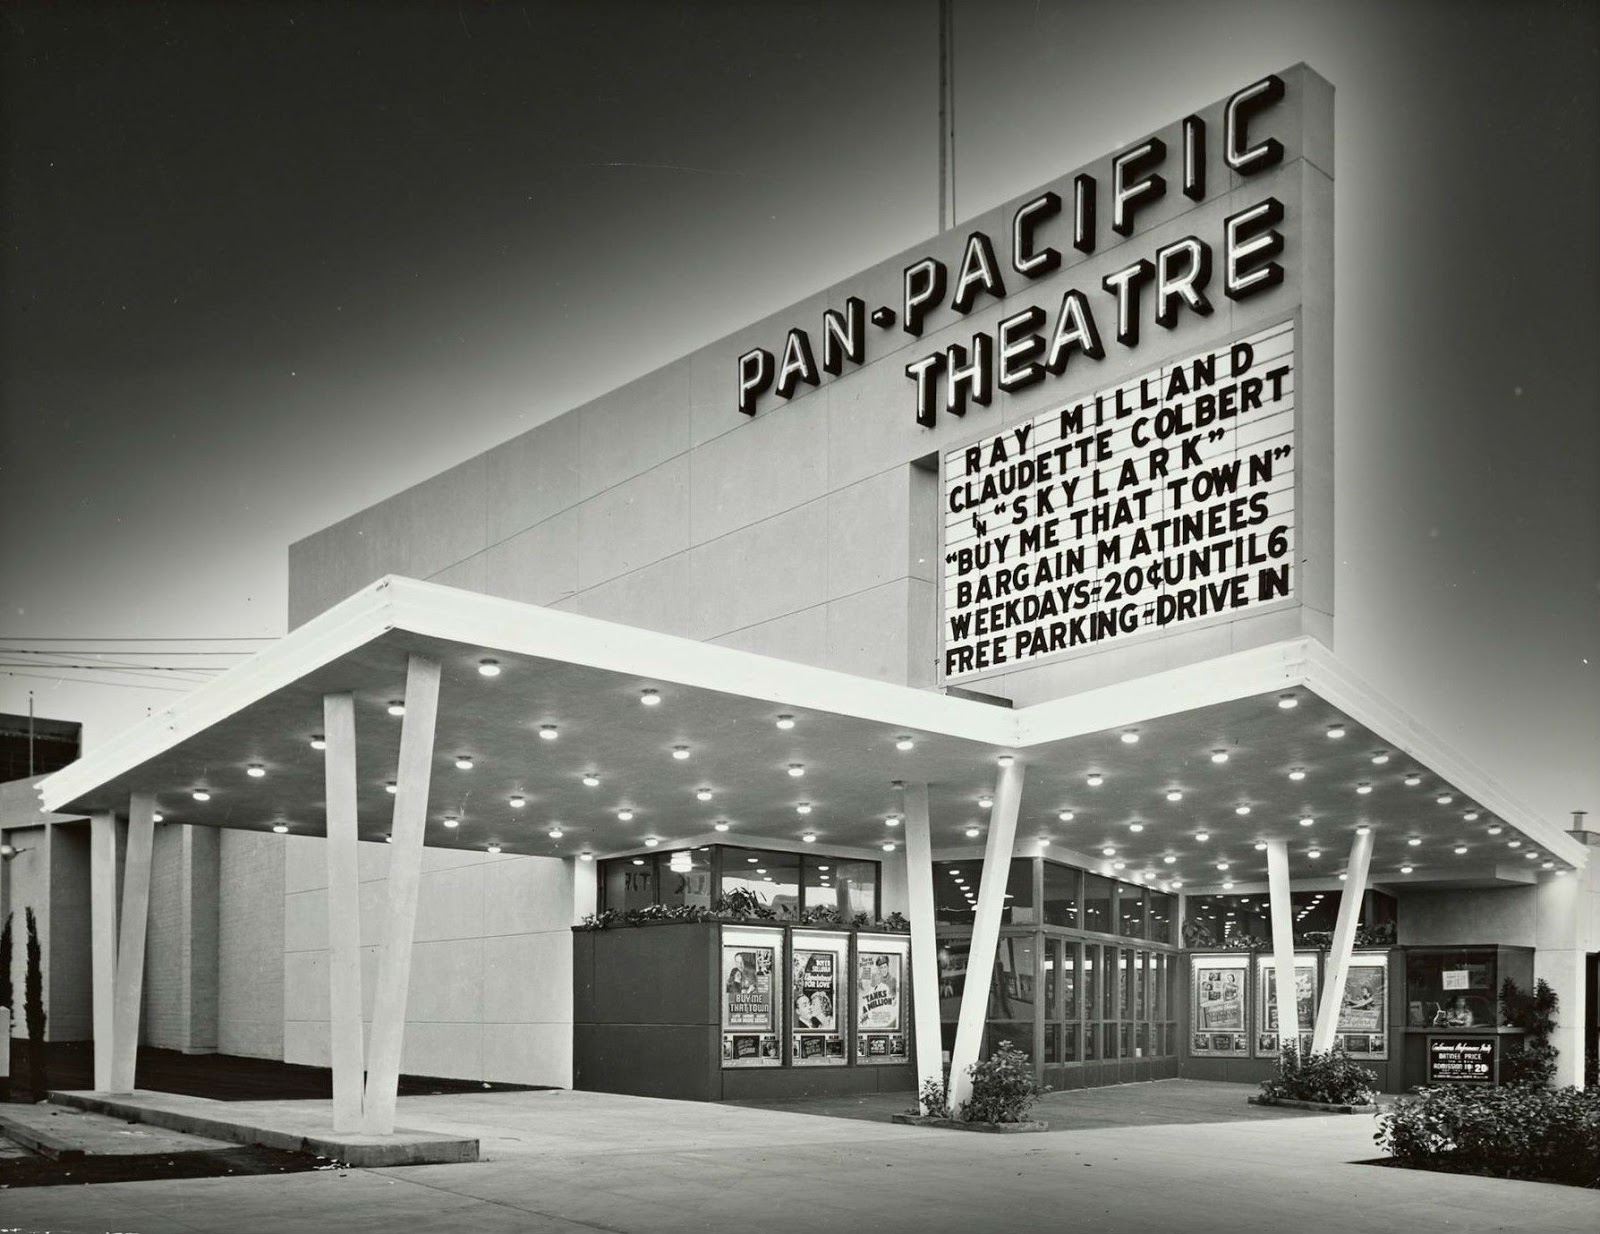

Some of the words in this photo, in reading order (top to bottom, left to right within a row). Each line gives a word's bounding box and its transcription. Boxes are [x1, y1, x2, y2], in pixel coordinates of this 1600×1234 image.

[905, 196, 1284, 428] THEATRE
[949, 429, 1113, 514] CLAUDETTE
[1131, 365, 1290, 448] COLBERT
[965, 424, 1032, 476] RAY
[1060, 342, 1254, 440] MILLAND
[957, 545, 1085, 609] BARGAIN
[1097, 491, 1269, 570] MATINEES
[1019, 518, 1060, 557] ME
[1070, 488, 1152, 539] THAT
[946, 636, 1007, 676] FREE
[1258, 563, 1290, 601] IN
[730, 1003, 749, 1013] THAT
[749, 1003, 769, 1013] TOWN
[736, 994, 750, 1003] BUY
[751, 994, 763, 1003] ME
